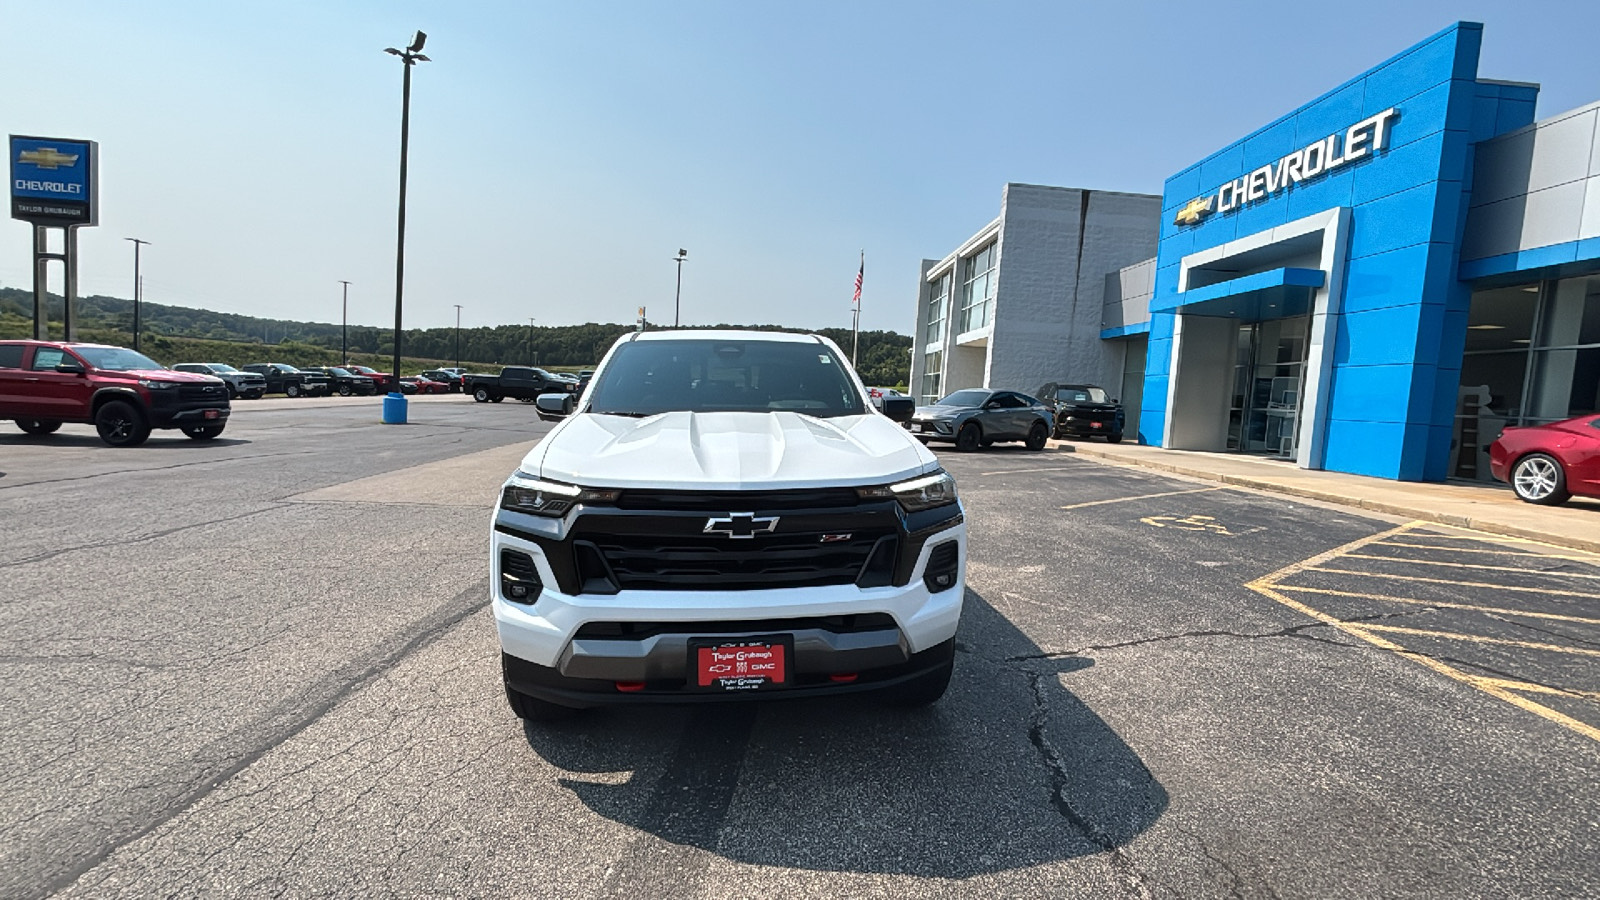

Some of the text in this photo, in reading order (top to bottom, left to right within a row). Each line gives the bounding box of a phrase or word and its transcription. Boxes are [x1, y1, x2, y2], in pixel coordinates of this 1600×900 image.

[1217, 107, 1398, 213] CHEVROLET
[15, 180, 82, 193] CHEVROLET
[18, 204, 81, 215] TAYLOR GRUBAUGH
[712, 651, 772, 662] Taylor Grubaugh
